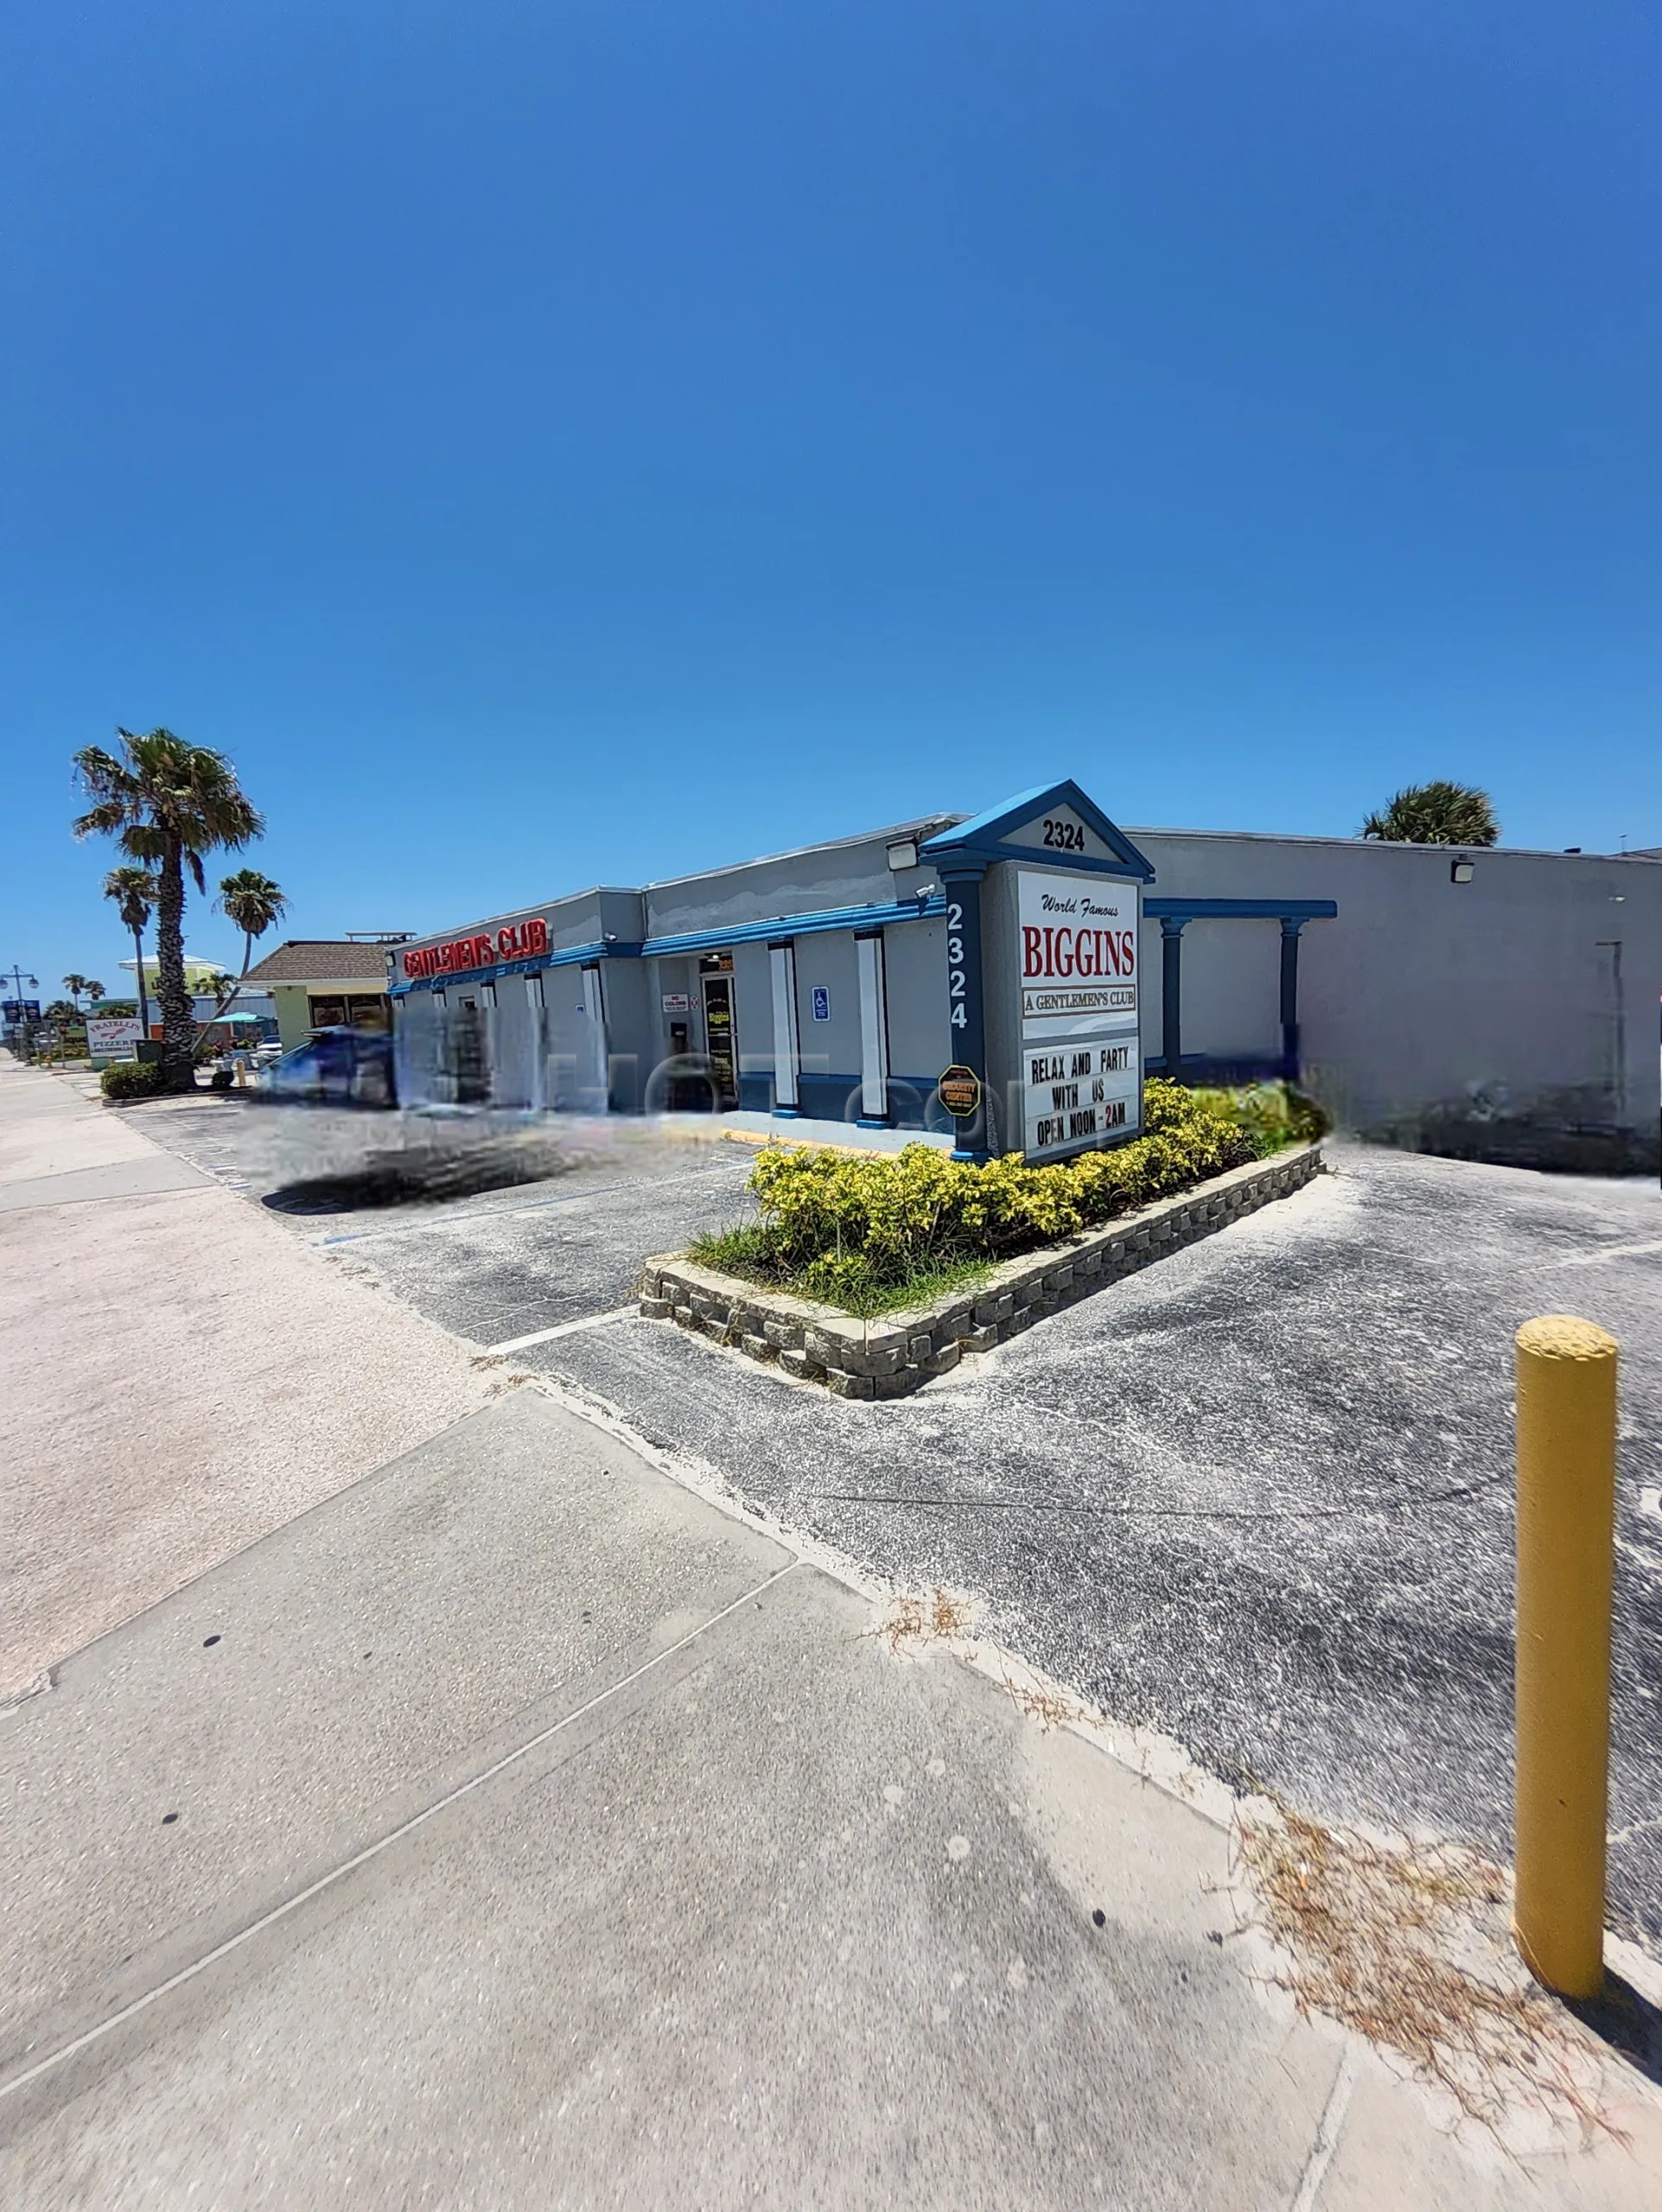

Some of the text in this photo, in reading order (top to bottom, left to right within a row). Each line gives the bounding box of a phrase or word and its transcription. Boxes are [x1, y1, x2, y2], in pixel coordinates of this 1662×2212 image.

[1042, 819, 1086, 852] 2324
[1041, 894, 1119, 918] World Famous
[498, 917, 548, 960] CLUB
[1022, 925, 1134, 977] BIGGINS
[1025, 990, 1134, 1011] A GENTLEMEN'S CLUB
[1031, 1046, 1129, 1084] RELAX AND PARTY
[1052, 1077, 1105, 1110] WITH US
[1037, 1116, 1065, 1147] OPEN
